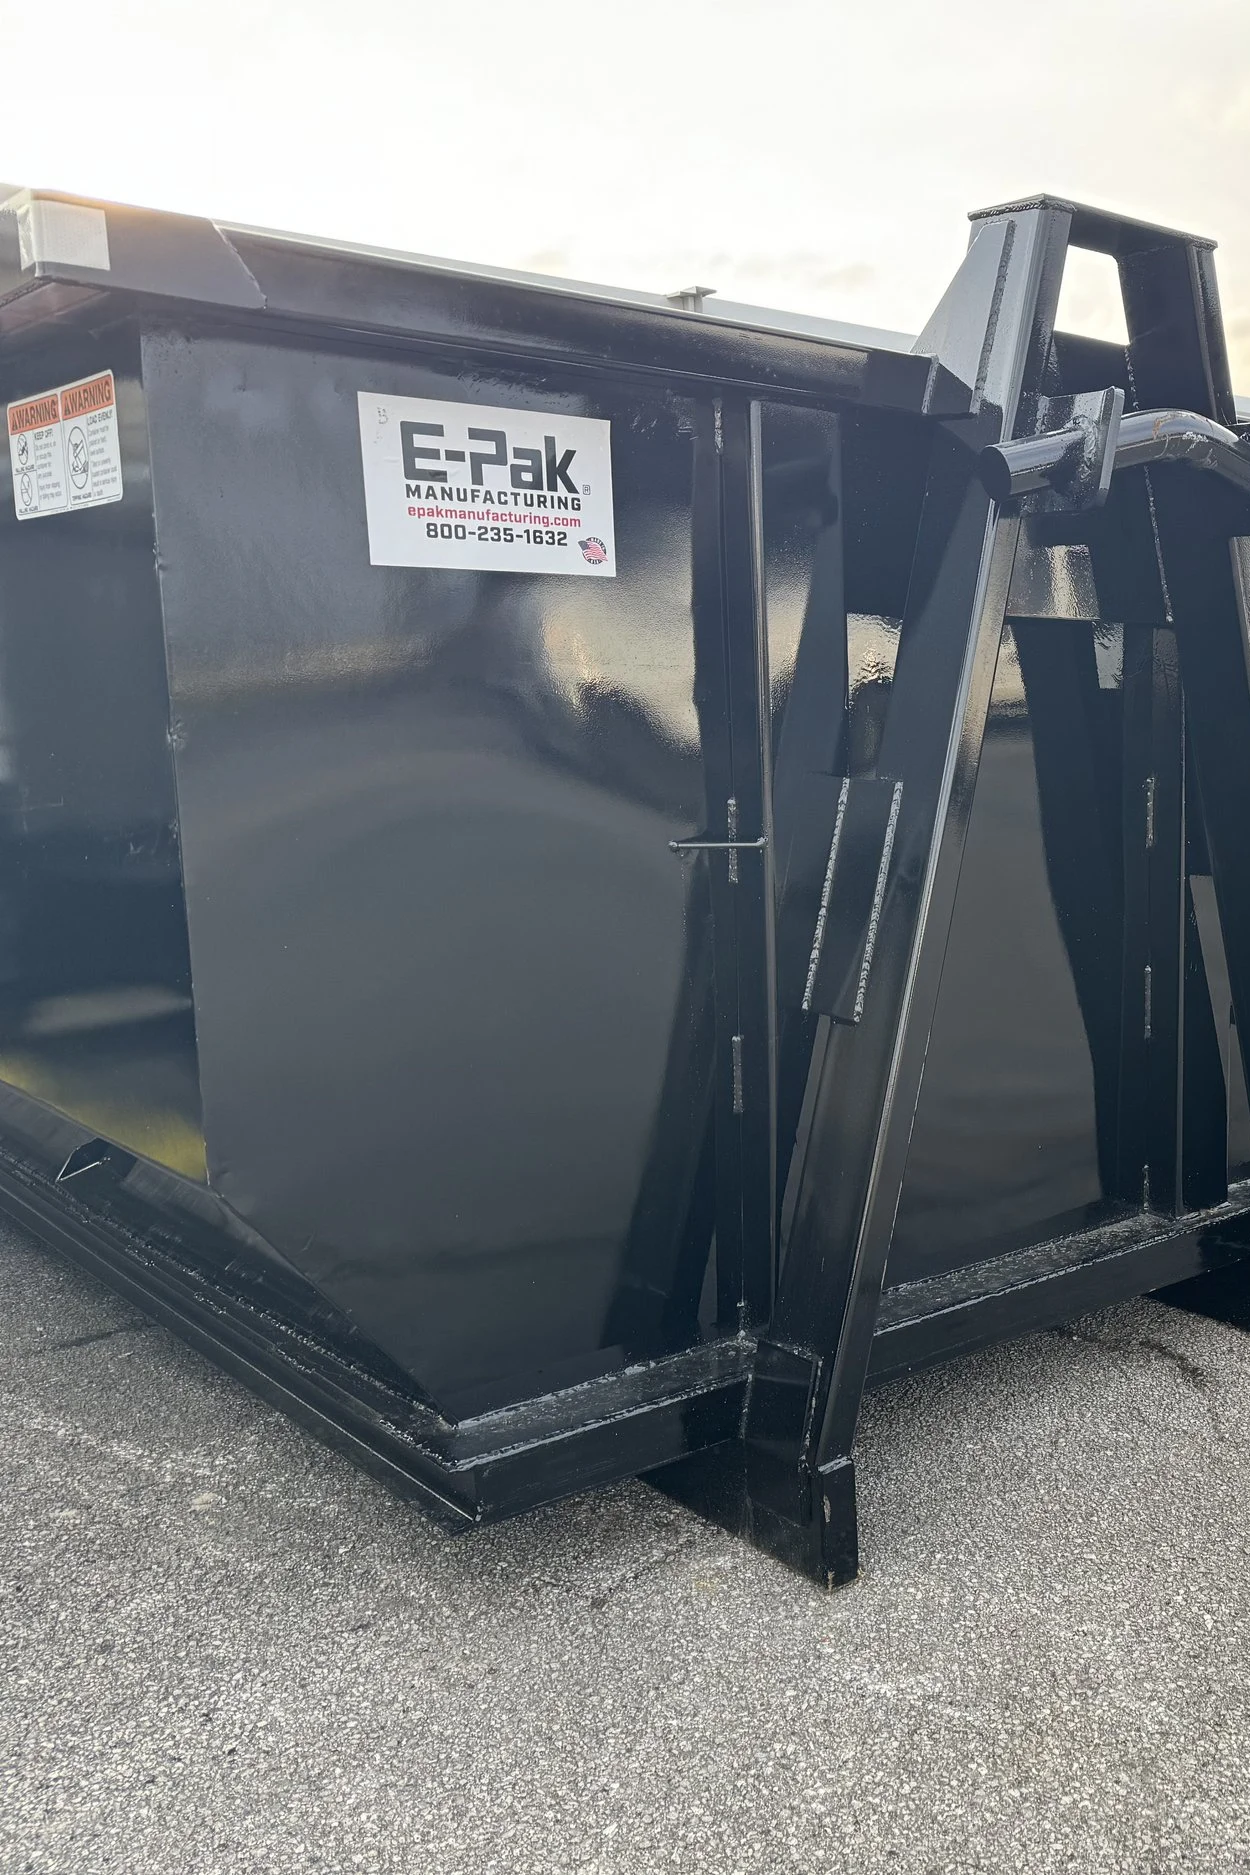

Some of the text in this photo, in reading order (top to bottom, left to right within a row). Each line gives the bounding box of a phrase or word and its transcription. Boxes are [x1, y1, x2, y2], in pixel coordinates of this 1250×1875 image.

[69, 380, 111, 413] WARNING
[16, 400, 57, 428] WARNING
[399, 420, 580, 495] E-Pak
[405, 483, 582, 512] MANUFACTURING
[407, 505, 581, 528] epakmanufacturing.com
[426, 522, 568, 547] 800-235-1632
